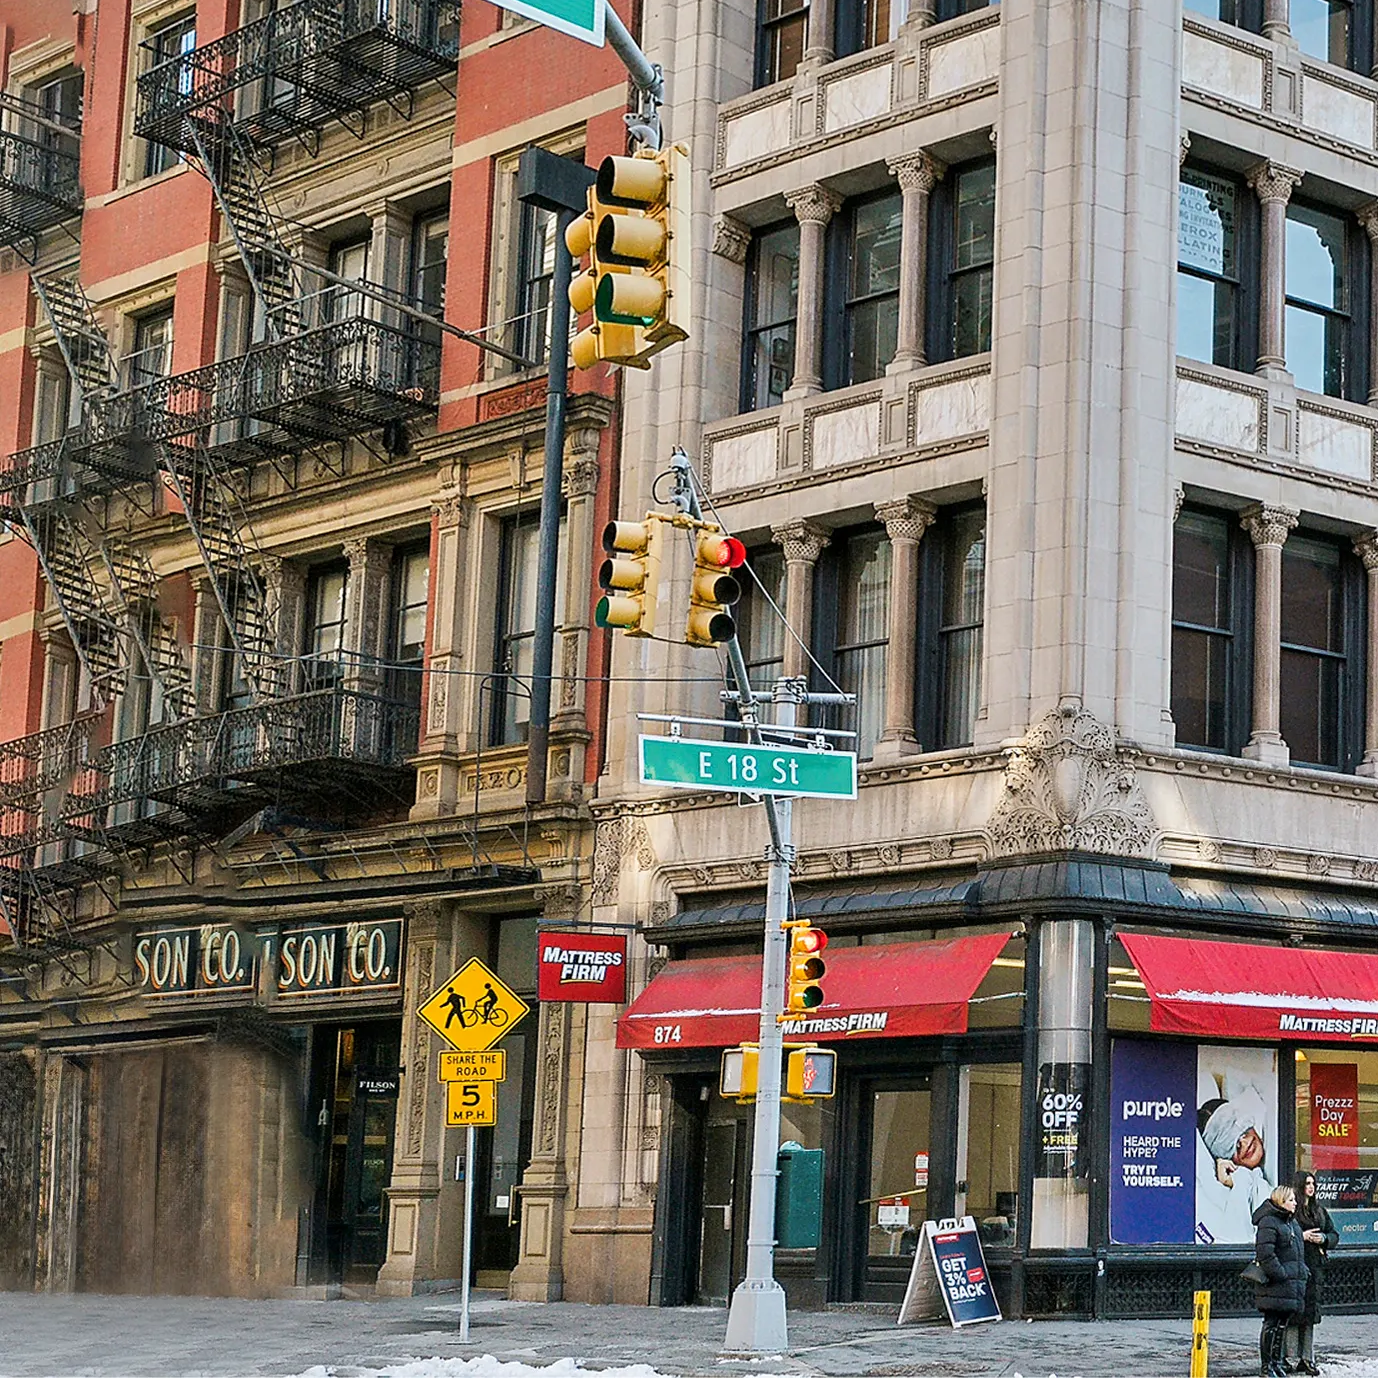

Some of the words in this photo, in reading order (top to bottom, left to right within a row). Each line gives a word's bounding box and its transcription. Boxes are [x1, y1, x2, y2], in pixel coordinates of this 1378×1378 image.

[700, 751, 712, 778] E
[727, 754, 758, 782] 18
[772, 757, 799, 785] St
[135, 935, 190, 989] SON
[279, 932, 336, 987] SON
[543, 946, 622, 965] MATTRESS
[561, 964, 607, 981] FIRM
[782, 1012, 888, 1035] MATTRESSFIRM
[654, 1025, 681, 1044] 874
[447, 1055, 476, 1064] SHARE
[480, 1054, 497, 1064] THE
[456, 1067, 487, 1076] ROAD
[359, 1081, 395, 1089] FILSON
[461, 1084, 480, 1106] 5
[1042, 1093, 1083, 1111] 60%
[1315, 1095, 1354, 1108] Prezzz
[453, 1110, 488, 1120] M.P.H.
[1123, 1097, 1184, 1121] purple
[1320, 1108, 1344, 1124] Day
[1042, 1111, 1079, 1128] OFF
[1318, 1124, 1349, 1137] SALE
[1050, 1134, 1079, 1145] FREE
[1123, 1135, 1160, 1148] HEARD
[1161, 1137, 1182, 1148] THE
[1123, 1147, 1158, 1158] HYPE?
[1123, 1164, 1146, 1176] TRY
[1146, 1165, 1158, 1176] IT
[1123, 1176, 1184, 1188] YOURSELF.
[1316, 1183, 1339, 1191] TAKE
[1339, 1183, 1349, 1192] IT
[941, 1256, 967, 1273] GET
[944, 1271, 967, 1287] 3%
[948, 1282, 986, 1300] BACK
